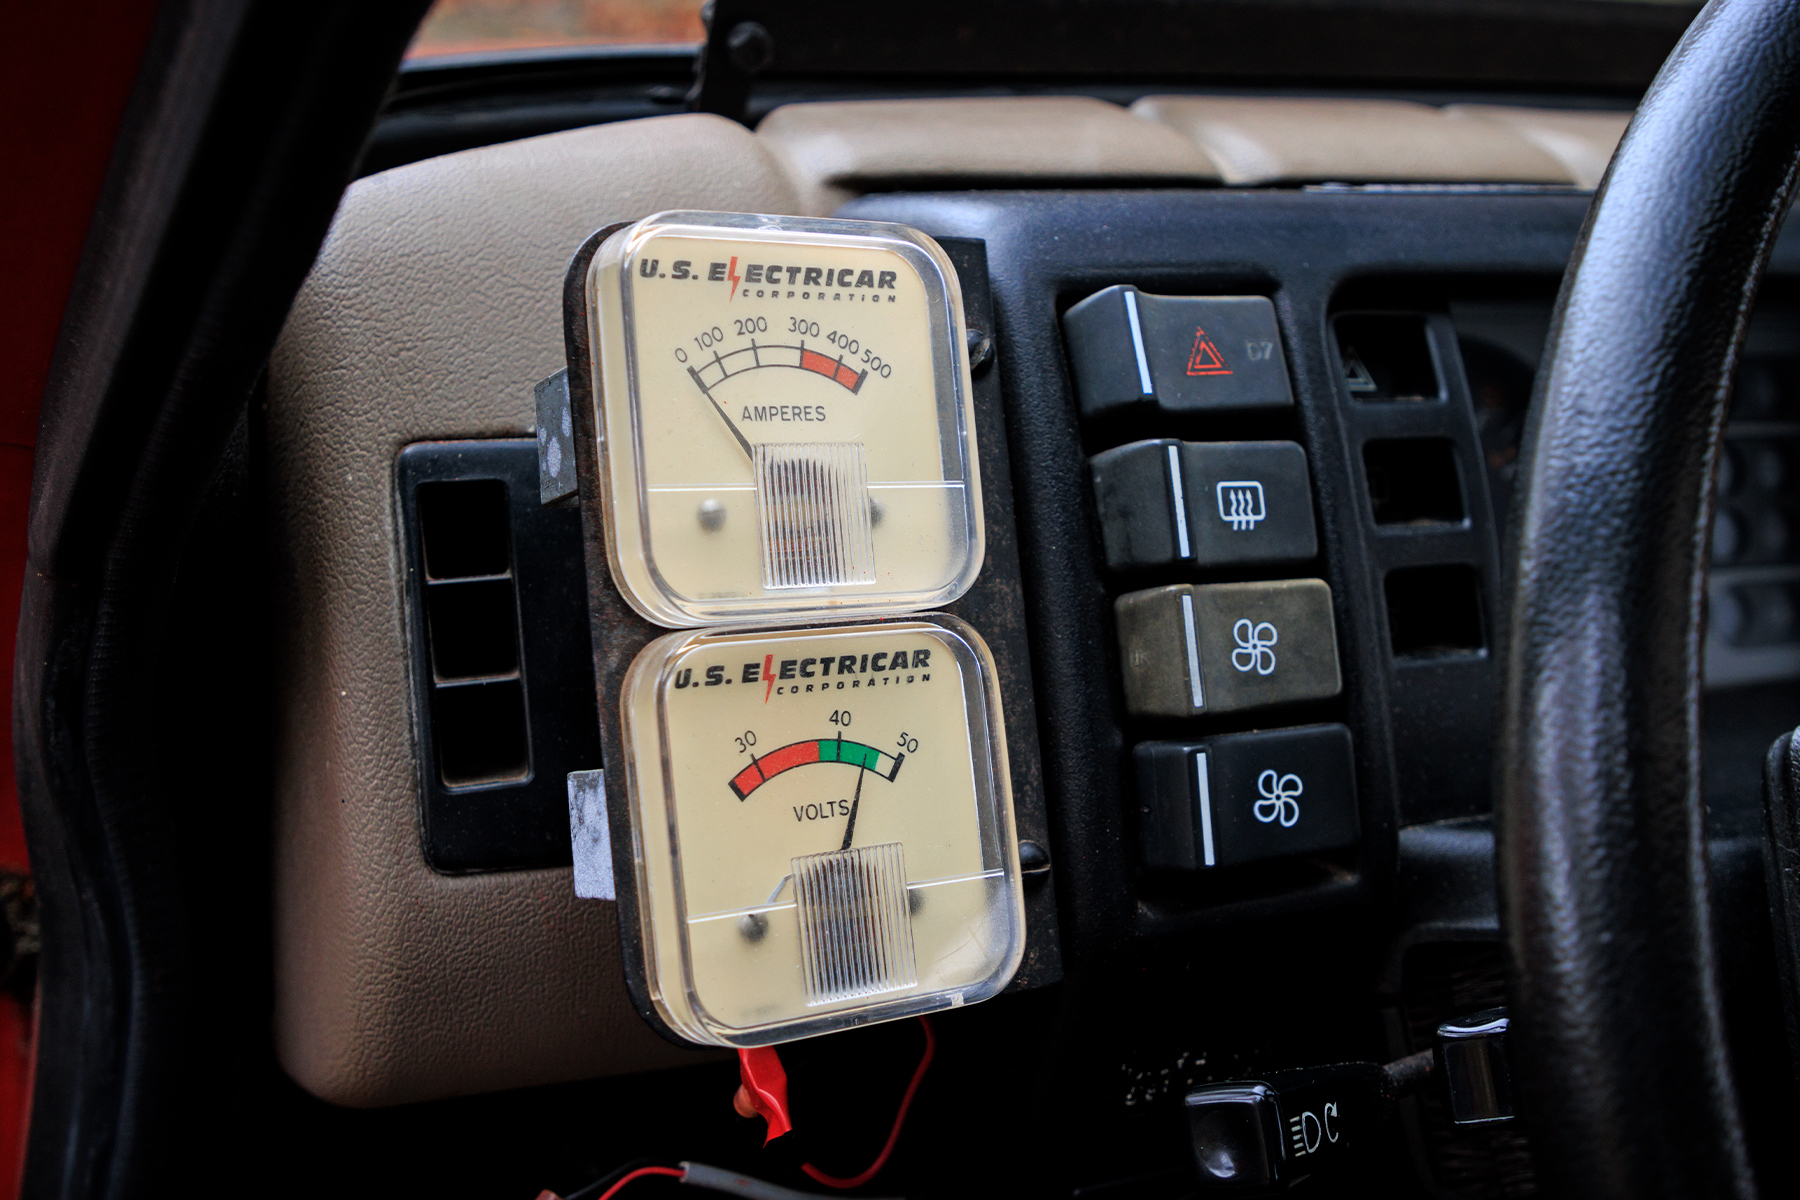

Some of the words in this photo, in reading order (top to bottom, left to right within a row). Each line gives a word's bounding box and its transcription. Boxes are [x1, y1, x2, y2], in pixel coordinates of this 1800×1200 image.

[639, 258, 699, 280] U.S.
[742, 288, 897, 303] CORPORATION
[675, 347, 688, 363] 0
[694, 326, 724, 352] 100
[734, 316, 768, 336] 200
[788, 316, 820, 338] 300
[827, 330, 860, 355] 400
[860, 348, 892, 379] 500
[741, 405, 827, 423] AMPERES
[674, 664, 732, 689] U.S.
[777, 673, 931, 695] CORPORATION
[734, 730, 757, 754] 30
[829, 710, 852, 727] 40
[896, 732, 919, 754] 50
[793, 800, 850, 822] VOLTS
